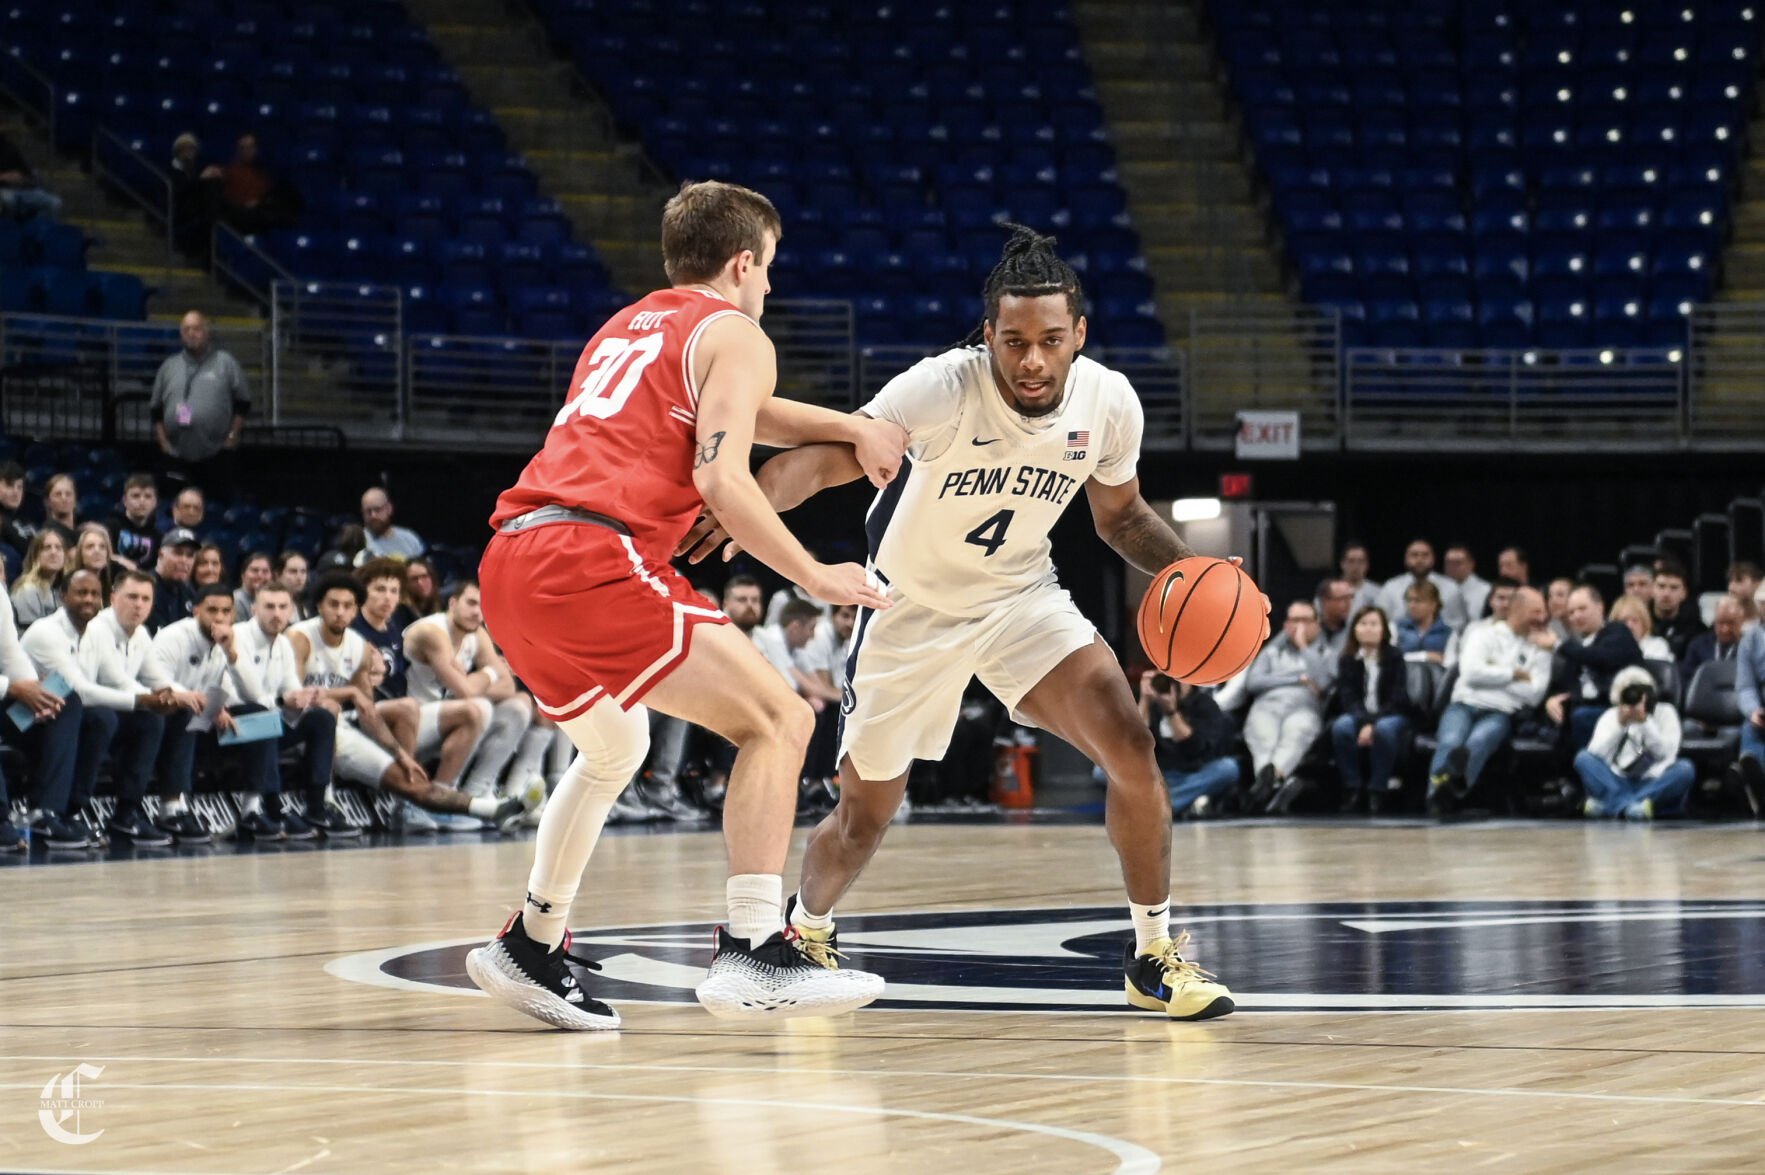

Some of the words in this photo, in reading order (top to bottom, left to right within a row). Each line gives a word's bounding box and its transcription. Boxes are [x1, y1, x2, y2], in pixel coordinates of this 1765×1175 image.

[553, 331, 664, 427] 30
[1240, 422, 1294, 446] EXIT
[938, 466, 1012, 500] PENN
[1011, 465, 1076, 505] STATE
[964, 508, 1015, 557] 4
